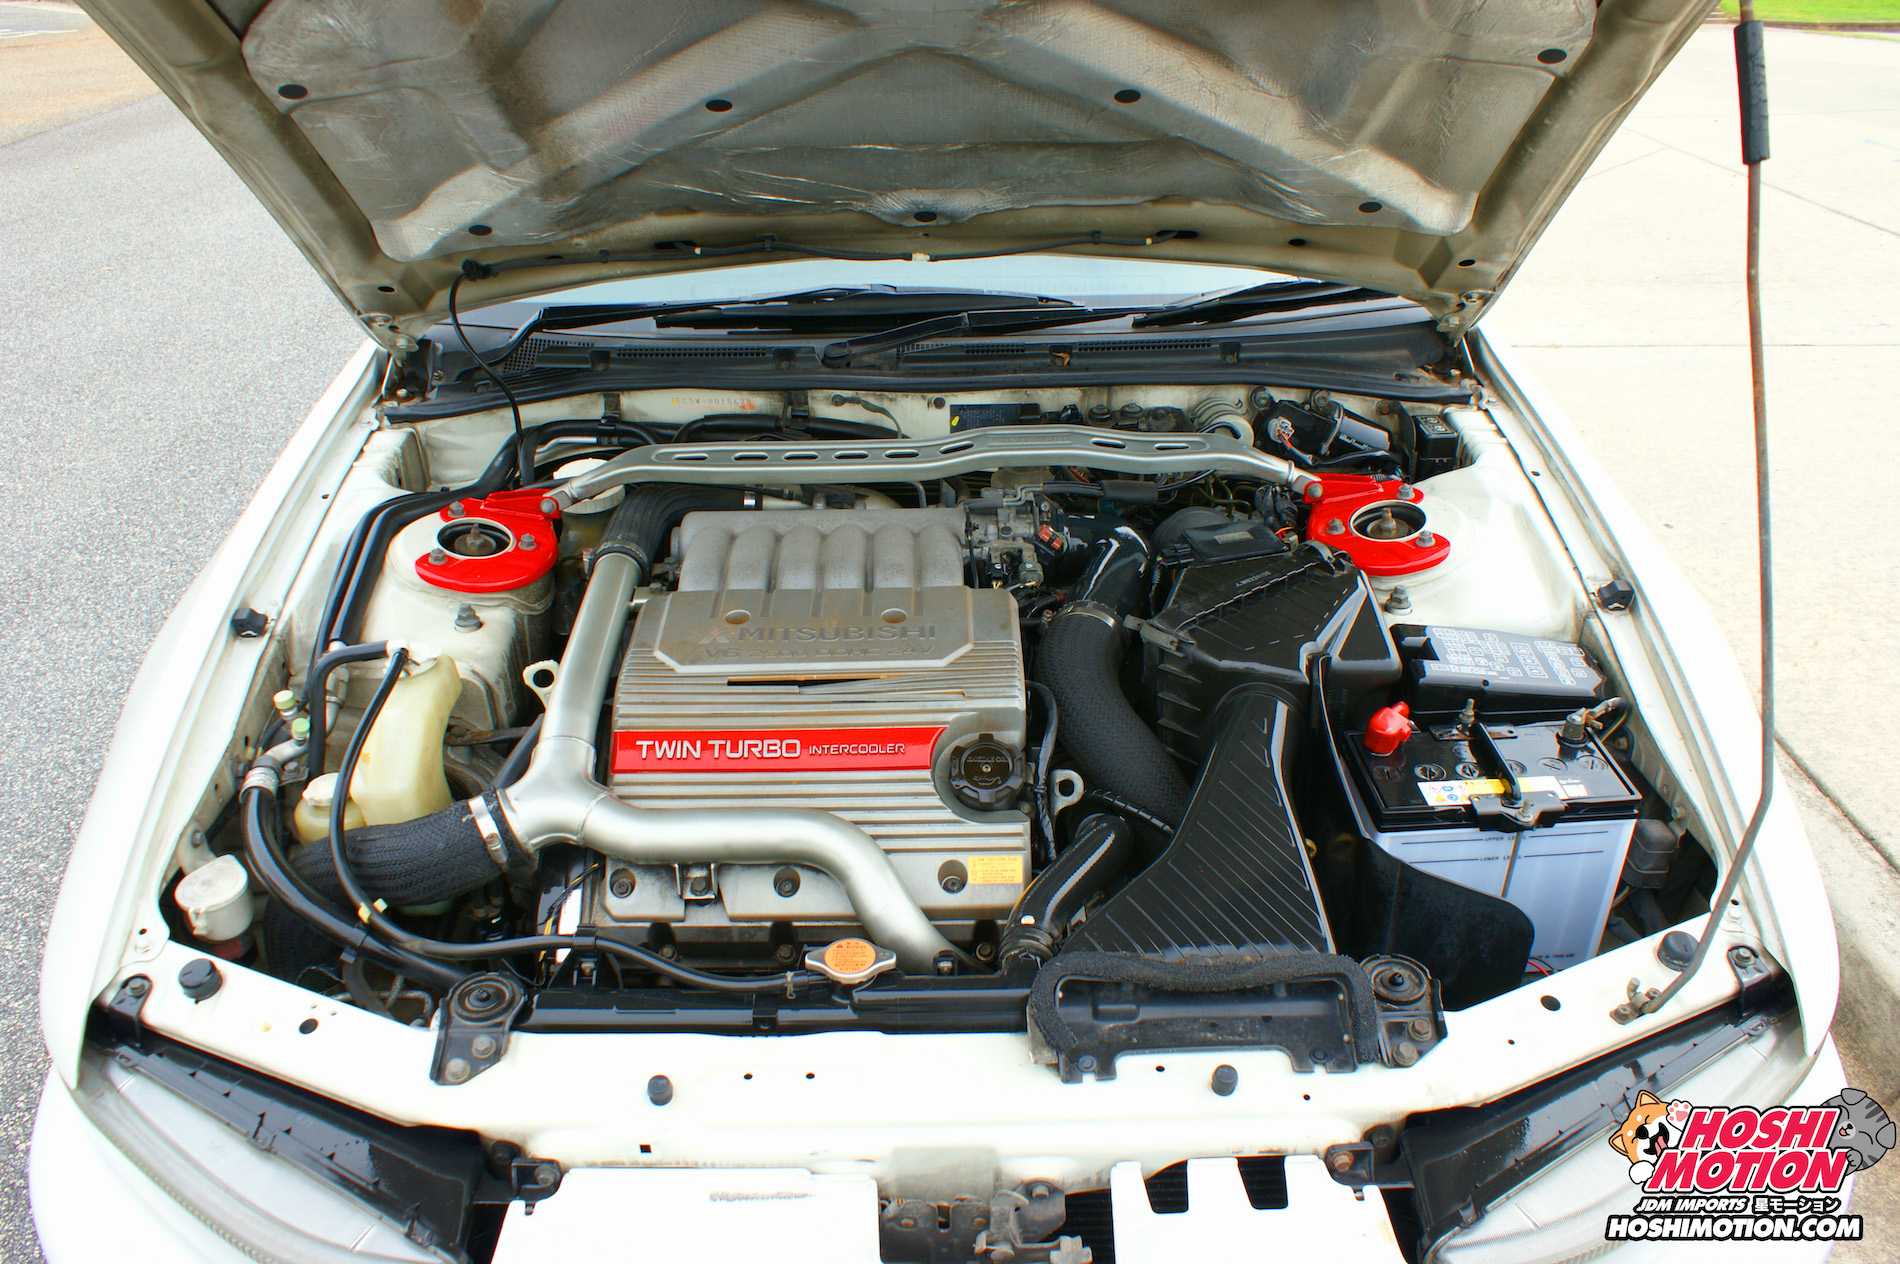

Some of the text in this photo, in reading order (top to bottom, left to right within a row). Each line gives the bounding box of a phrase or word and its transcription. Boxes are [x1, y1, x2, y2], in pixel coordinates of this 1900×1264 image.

[737, 625, 936, 643] MITSUBISHI
[887, 646, 935, 657] 24V
[636, 738, 905, 760] TWIN TURBO INTERCOOLER
